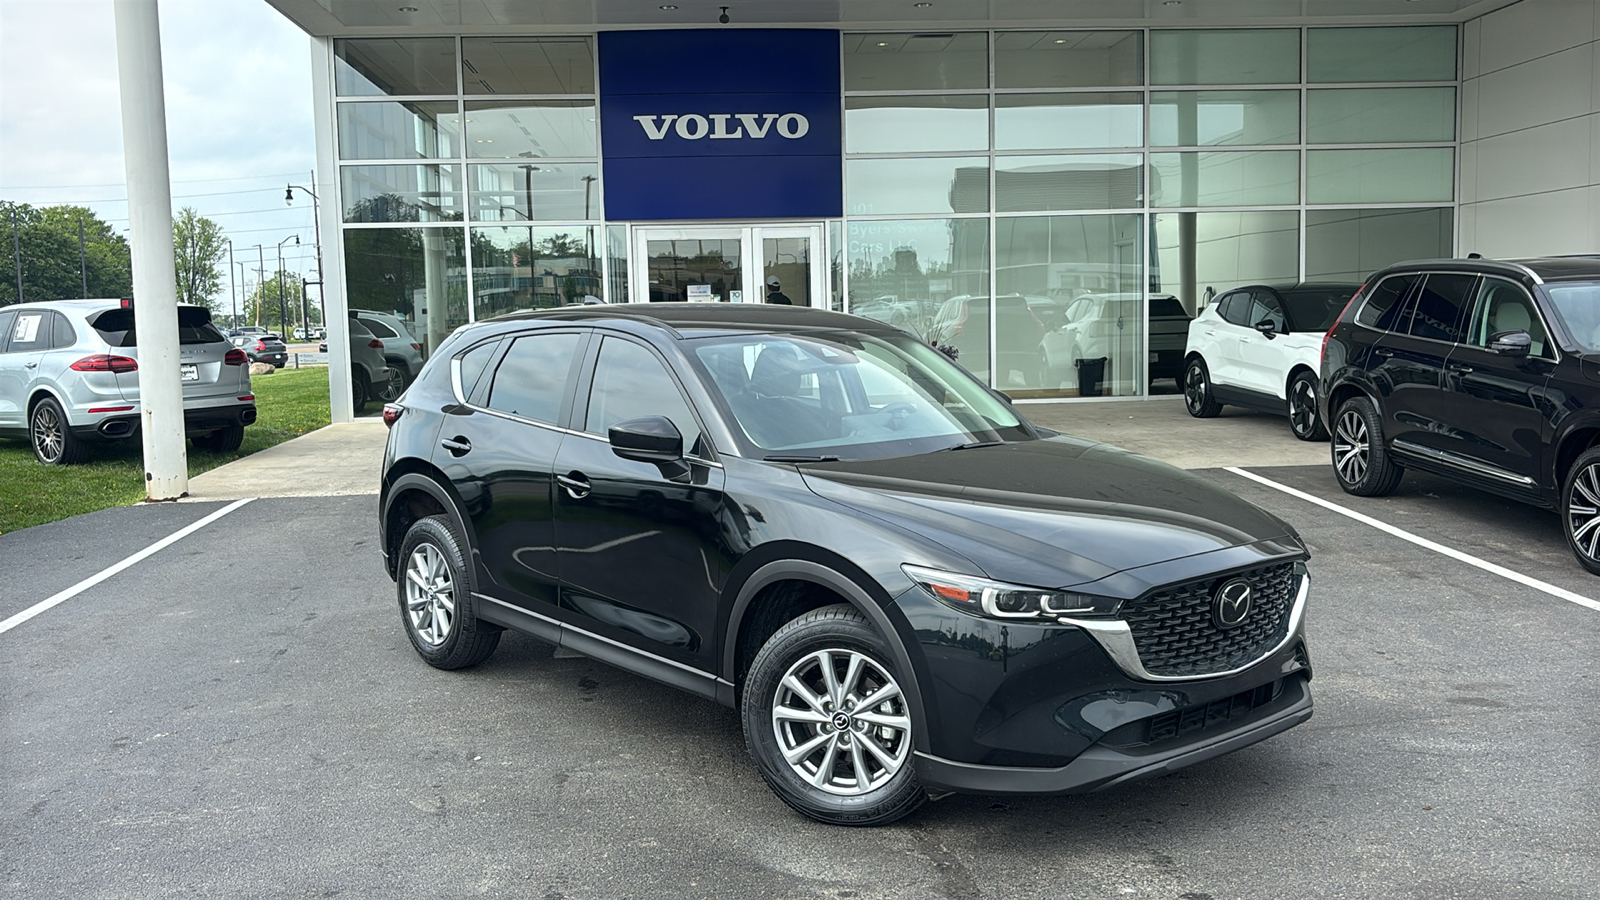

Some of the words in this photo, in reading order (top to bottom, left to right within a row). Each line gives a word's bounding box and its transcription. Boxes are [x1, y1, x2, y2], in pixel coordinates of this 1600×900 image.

[633, 113, 809, 140] VOLVO
[849, 223, 891, 239] Byers
[849, 240, 884, 253] Cars
